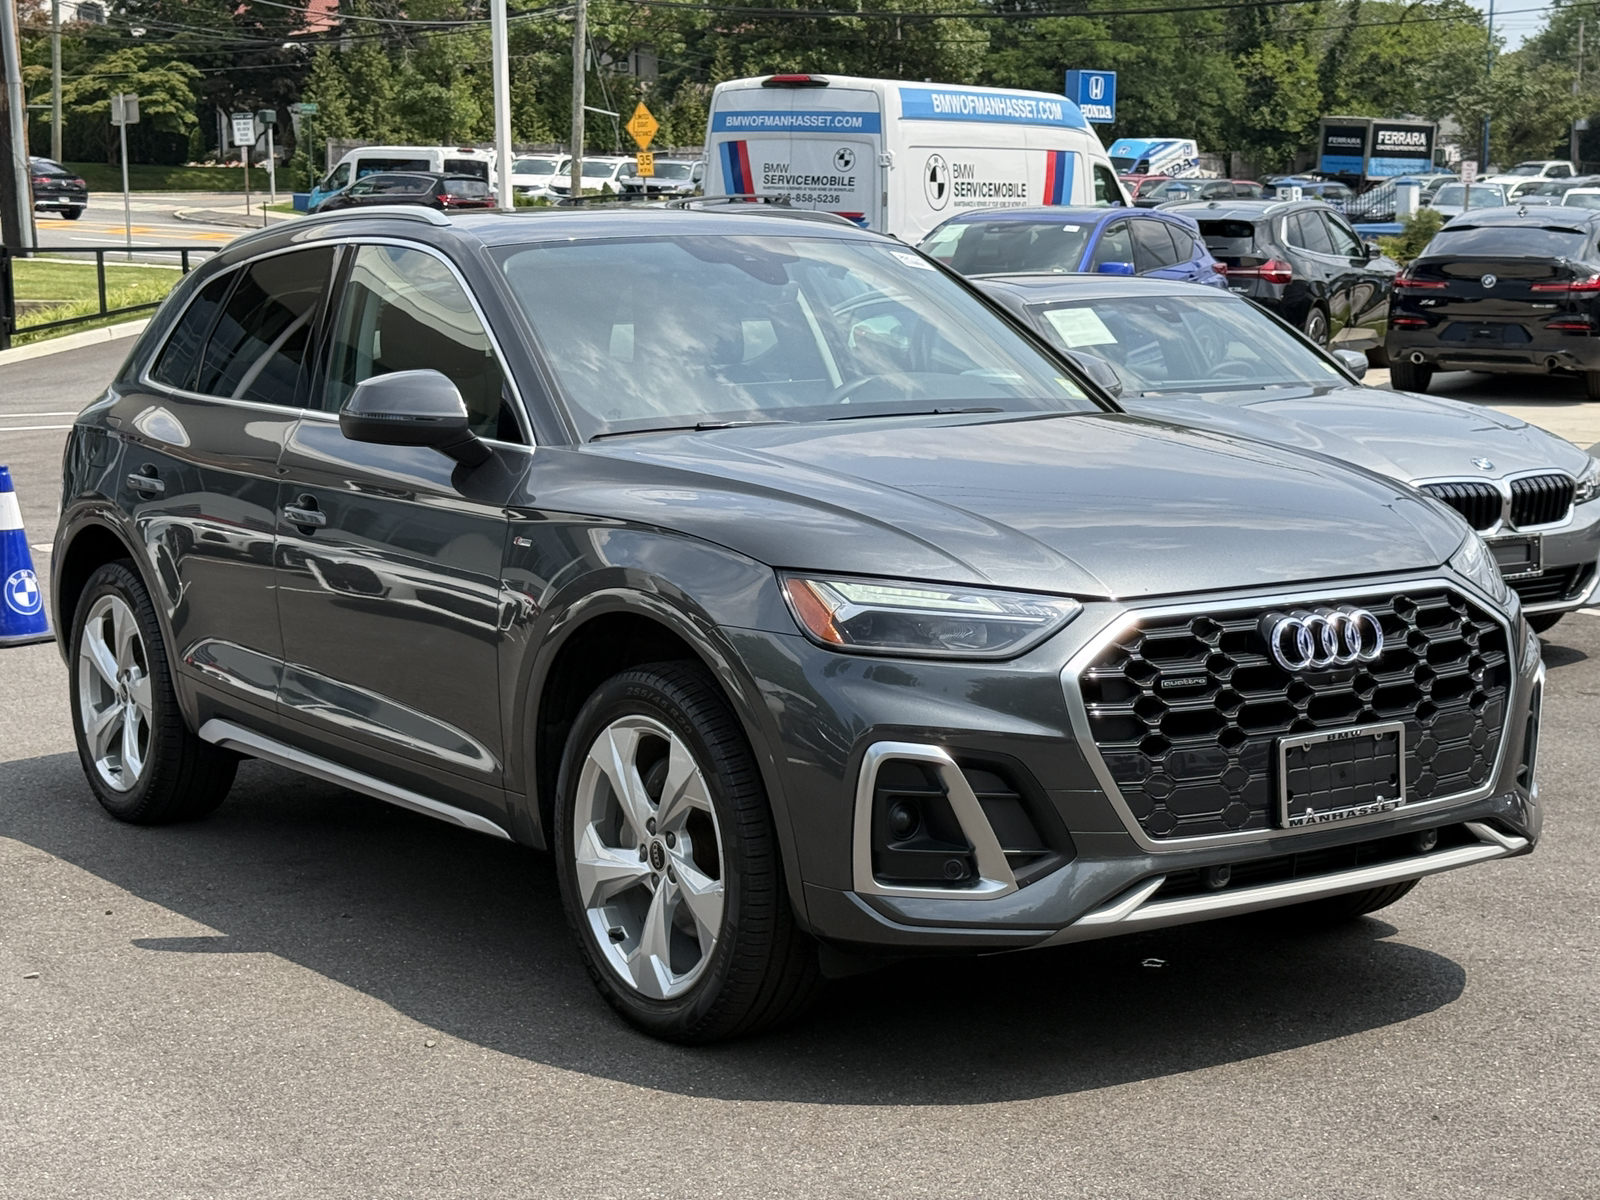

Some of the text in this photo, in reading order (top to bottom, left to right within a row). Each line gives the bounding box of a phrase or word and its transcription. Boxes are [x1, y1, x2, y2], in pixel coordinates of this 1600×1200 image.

[931, 93, 1063, 121] BMWOFMANHASSET.COM
[1080, 103, 1112, 119] HONDA
[725, 115, 863, 128] BMWOFMANHASSET.COM
[1327, 136, 1361, 145] FERRARA
[1377, 130, 1427, 145] FERRARA
[639, 155, 652, 166] 35
[763, 163, 789, 173] BMW
[953, 163, 974, 179] BMW
[763, 174, 855, 187] SERVICEMOBILE
[953, 182, 1026, 198] SERVICEMOBILE
[778, 193, 840, 204] 6-858-5236
[1164, 678, 1206, 688] quattro
[626, 686, 669, 709] 255/45
[1327, 730, 1362, 741] BMW
[1289, 802, 1399, 827] MANHASSET
